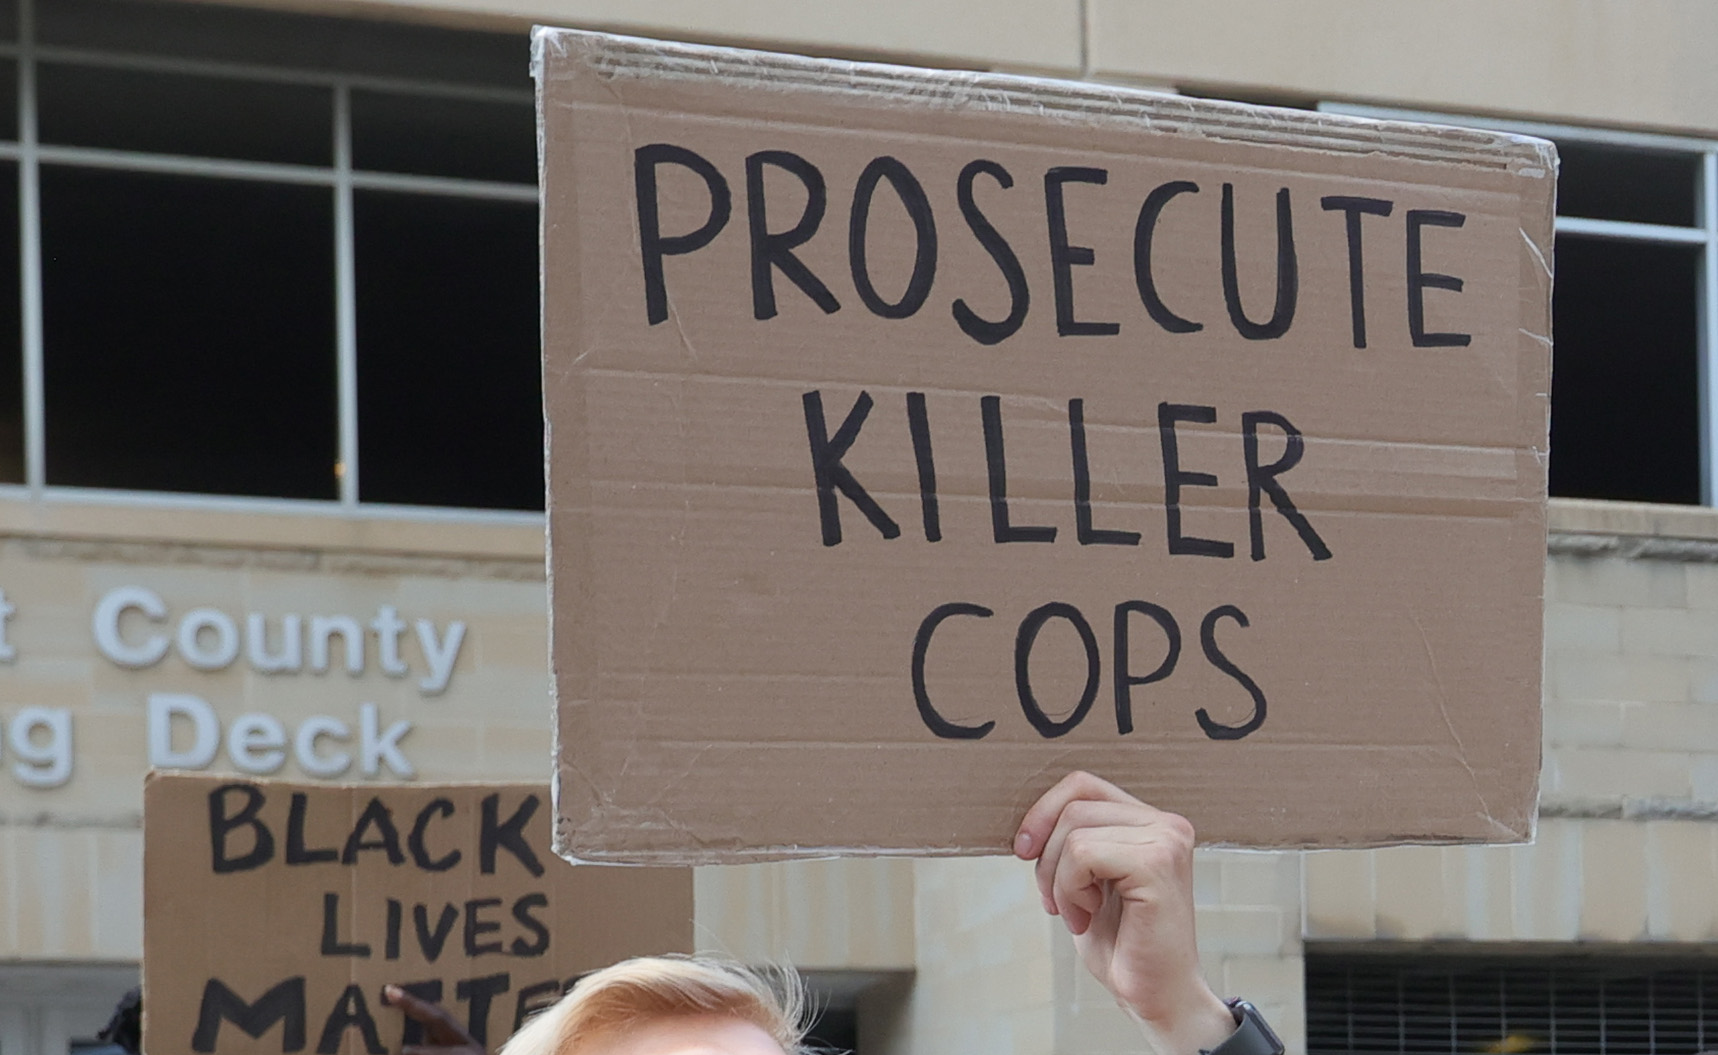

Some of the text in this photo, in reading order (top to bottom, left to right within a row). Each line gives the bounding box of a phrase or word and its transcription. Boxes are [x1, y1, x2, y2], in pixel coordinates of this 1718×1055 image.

[634, 143, 1471, 350] PROSECUTE
[803, 390, 1333, 561] KILLER
[93, 587, 466, 696] County
[912, 600, 1267, 740] COPS
[147, 694, 415, 780] Deck
[207, 783, 546, 878] BLACK
[320, 893, 551, 961] LIVES
[192, 973, 585, 1055] MATTE
